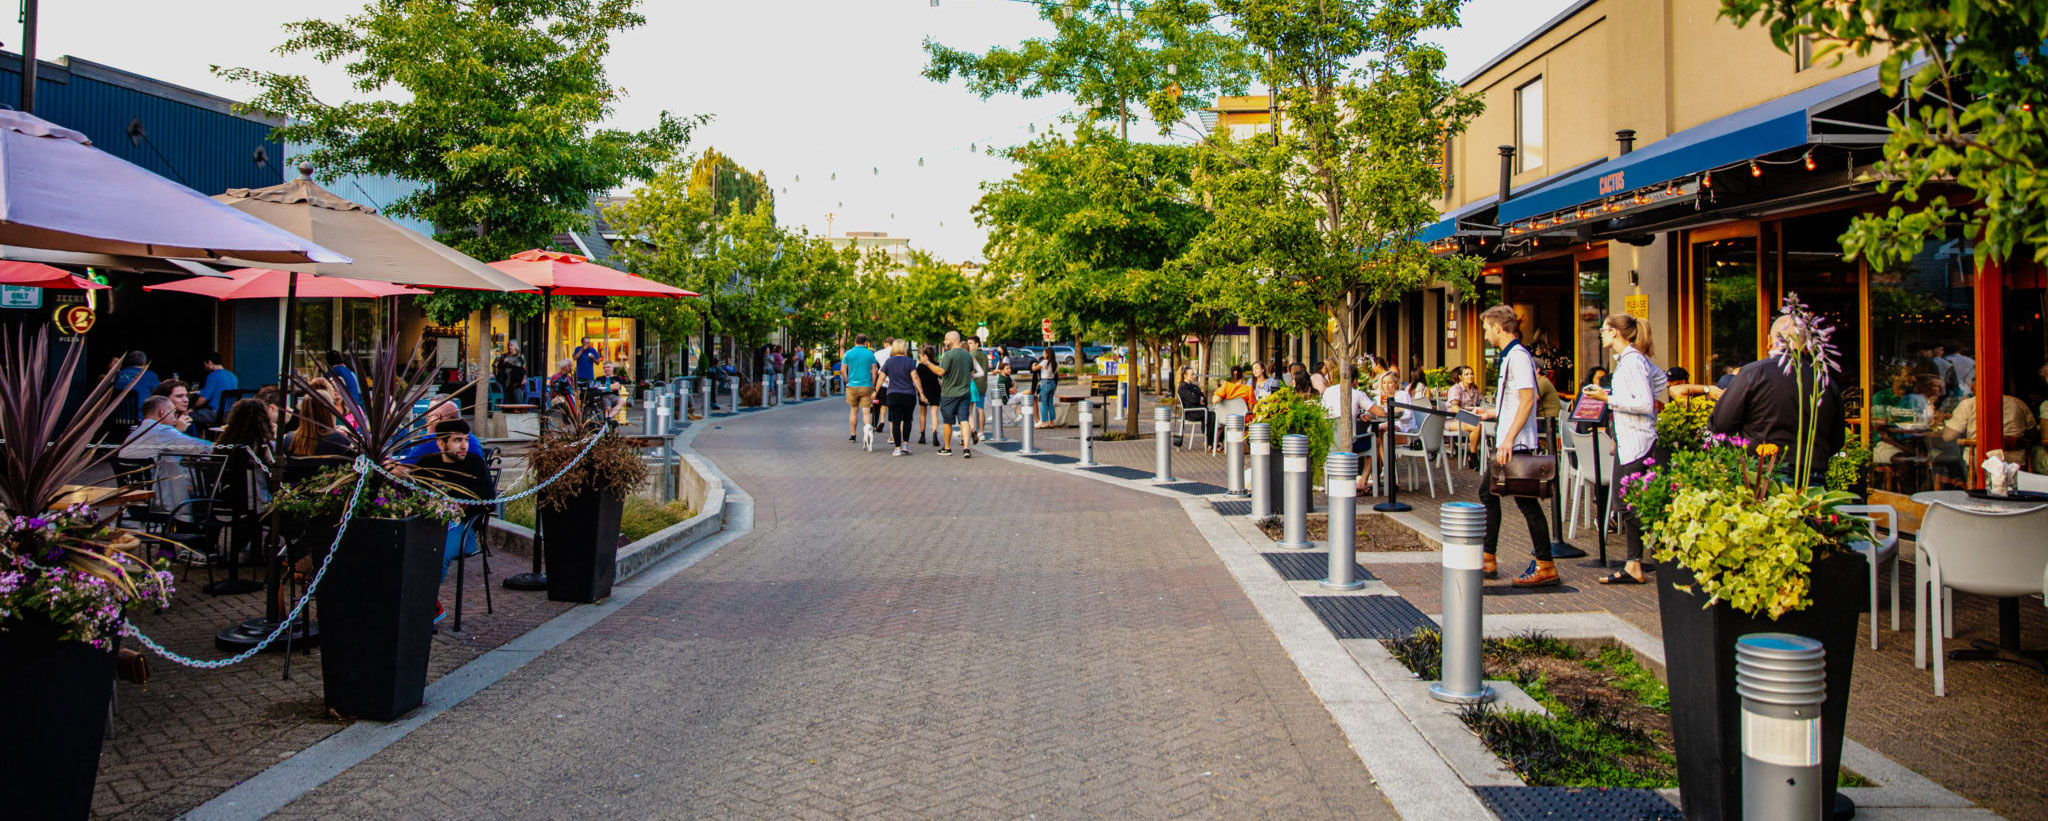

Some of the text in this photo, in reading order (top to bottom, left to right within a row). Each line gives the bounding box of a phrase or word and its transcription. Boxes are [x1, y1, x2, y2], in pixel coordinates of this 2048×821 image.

[1599, 170, 1625, 195] CACTUS
[11, 292, 29, 300] ONLY
[75, 311, 89, 328] Z
